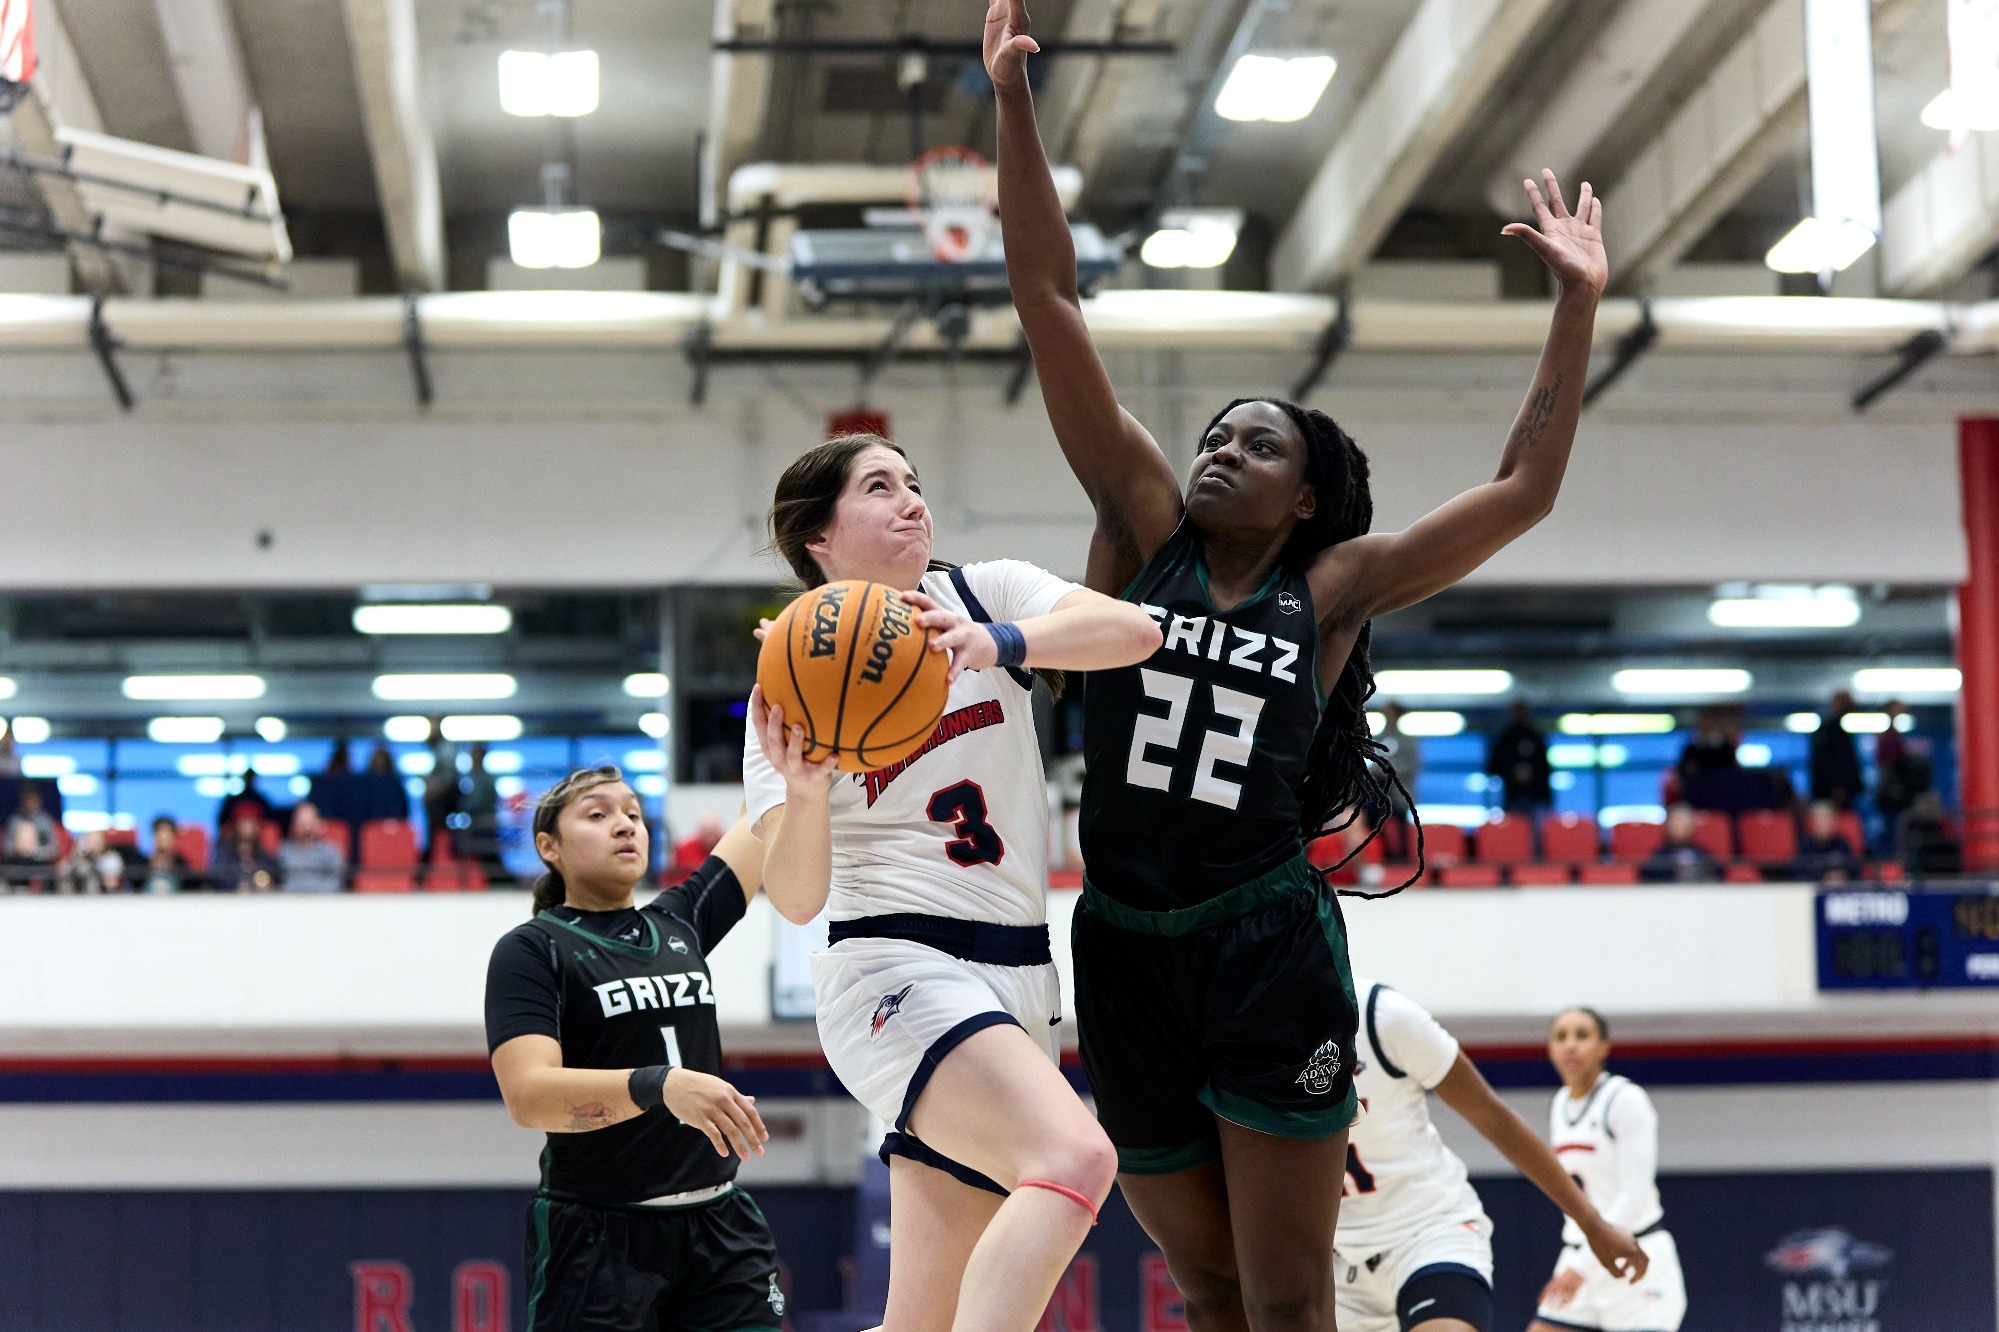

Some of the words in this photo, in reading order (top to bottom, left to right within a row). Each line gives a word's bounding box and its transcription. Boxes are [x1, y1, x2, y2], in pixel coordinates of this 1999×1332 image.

[808, 587, 849, 659] NCAA
[860, 588, 913, 685] Wilson
[1140, 602, 1300, 684] RIZZ
[1280, 599, 1299, 610] MAC
[1126, 667, 1266, 811] 22
[926, 779, 1005, 867] 3
[593, 971, 715, 1018] GRIZZ
[1300, 1063, 1338, 1081] ADAMS
